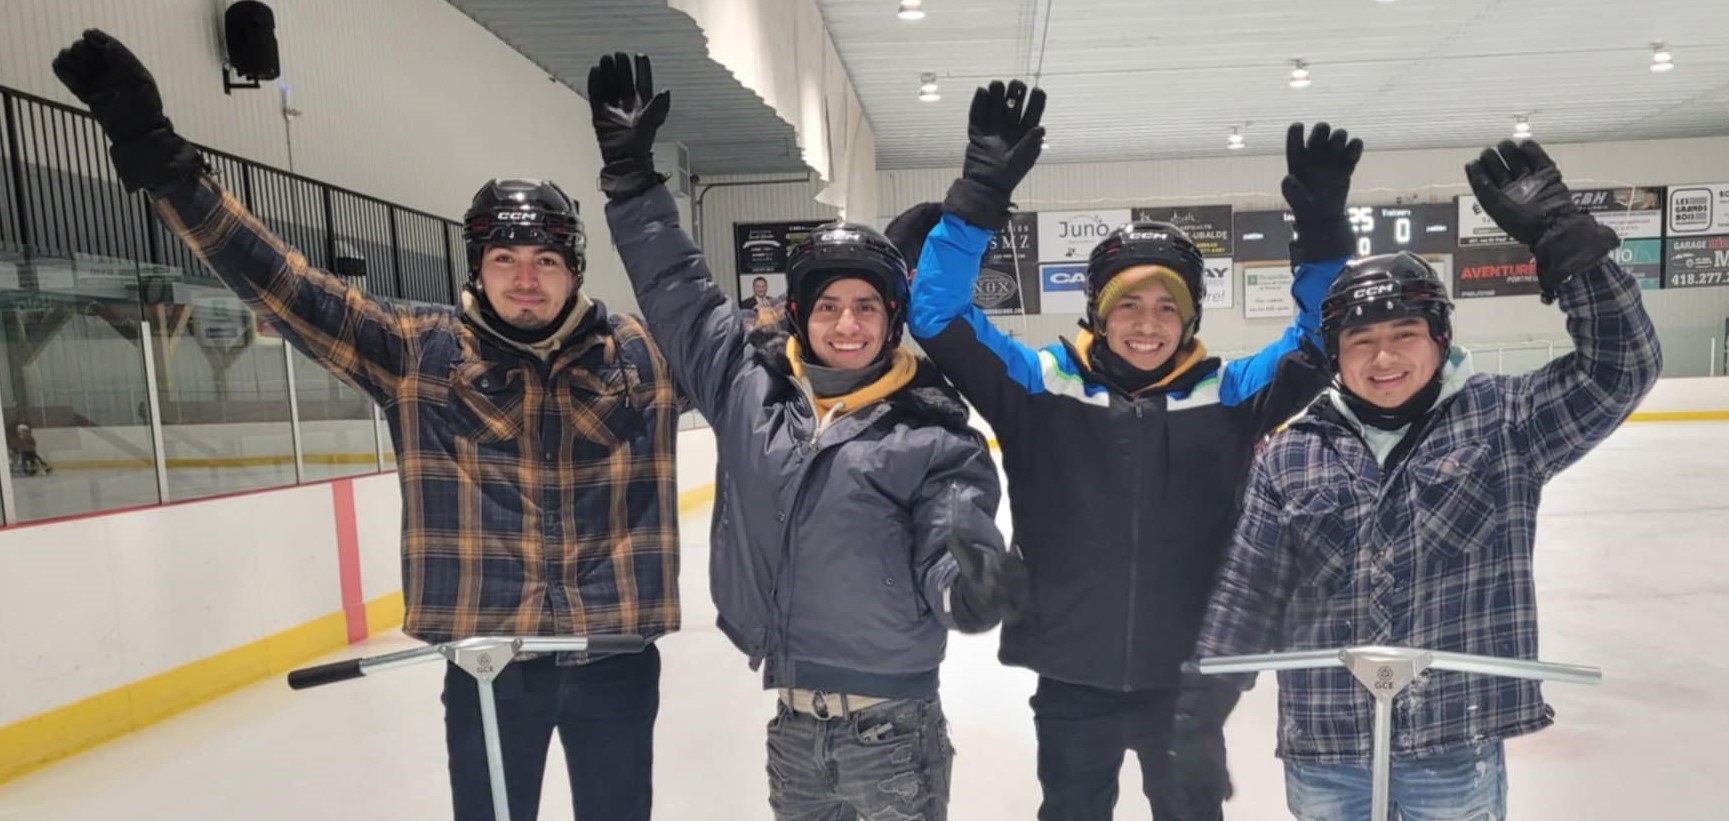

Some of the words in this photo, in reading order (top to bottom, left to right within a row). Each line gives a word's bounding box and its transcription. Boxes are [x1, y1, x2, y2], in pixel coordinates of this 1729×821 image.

[1571, 191, 1607, 206] GBH
[1675, 205, 1708, 213] GRANDS
[498, 212, 537, 220] CCM
[1675, 213, 1695, 221] BOIS
[1058, 221, 1110, 238] Juno
[1395, 217, 1411, 243] 0
[821, 231, 860, 241] CCM
[1128, 232, 1168, 240] CCM
[1357, 236, 1371, 255] 0
[1673, 240, 1706, 250] GARAGE
[1353, 283, 1394, 299] CCM
[1374, 681, 1394, 690] GCE
